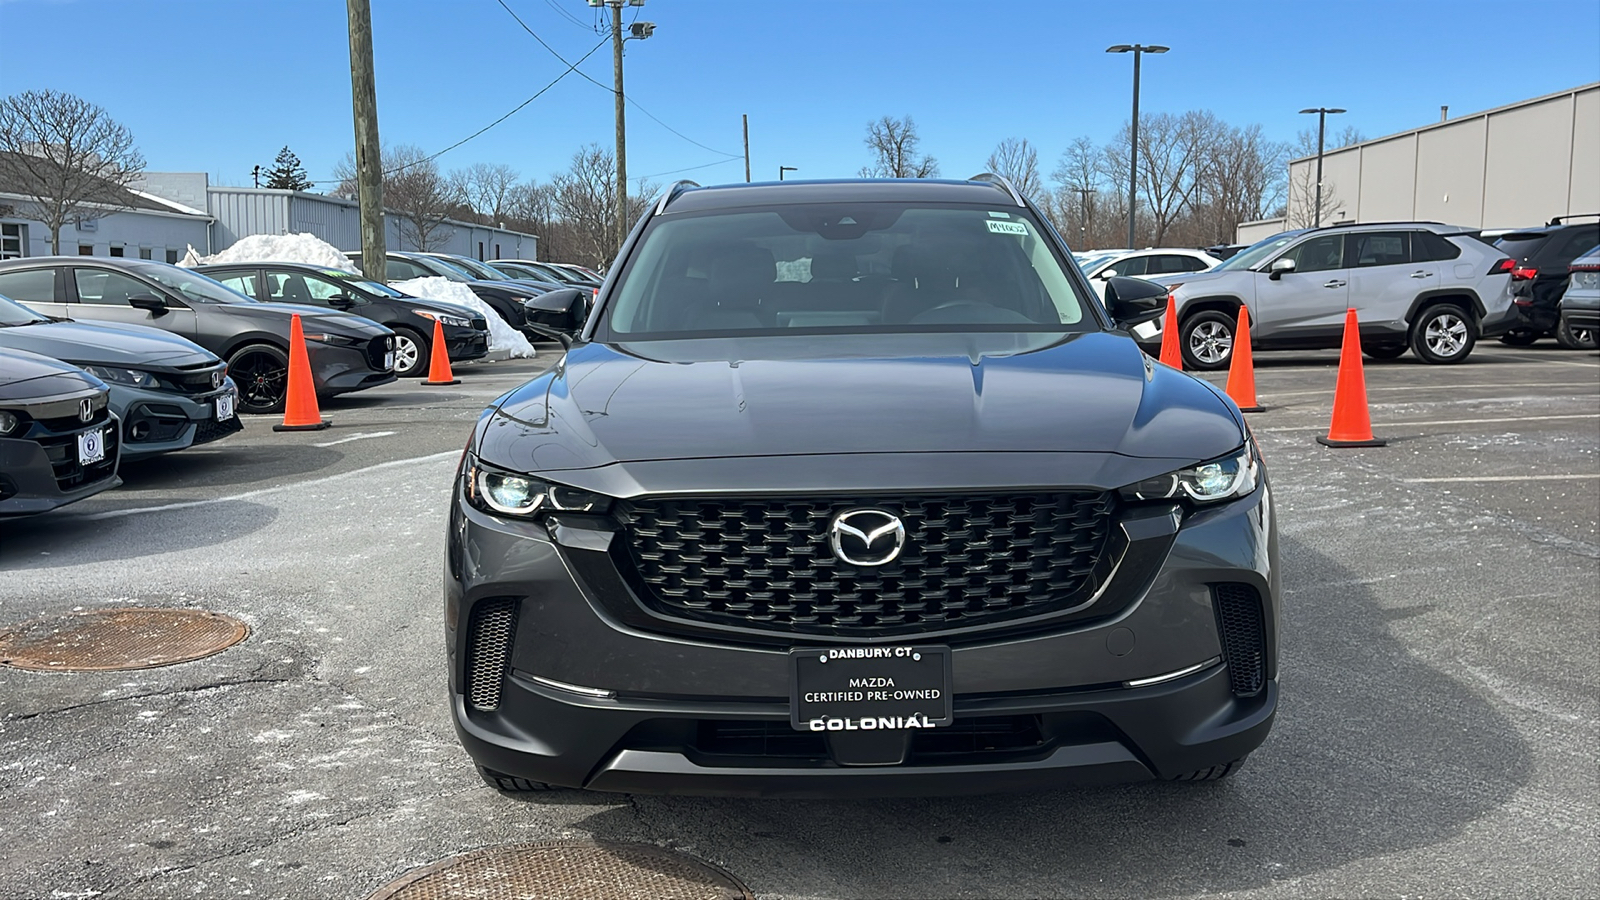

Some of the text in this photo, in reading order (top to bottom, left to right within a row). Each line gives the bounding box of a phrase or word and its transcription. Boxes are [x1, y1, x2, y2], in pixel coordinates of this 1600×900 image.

[829, 647, 913, 659] DANBURY, CT
[849, 677, 895, 688] MAZDA
[804, 689, 941, 703] CERTIFIED PRE-OWNED
[809, 716, 936, 731] COLONIAL
